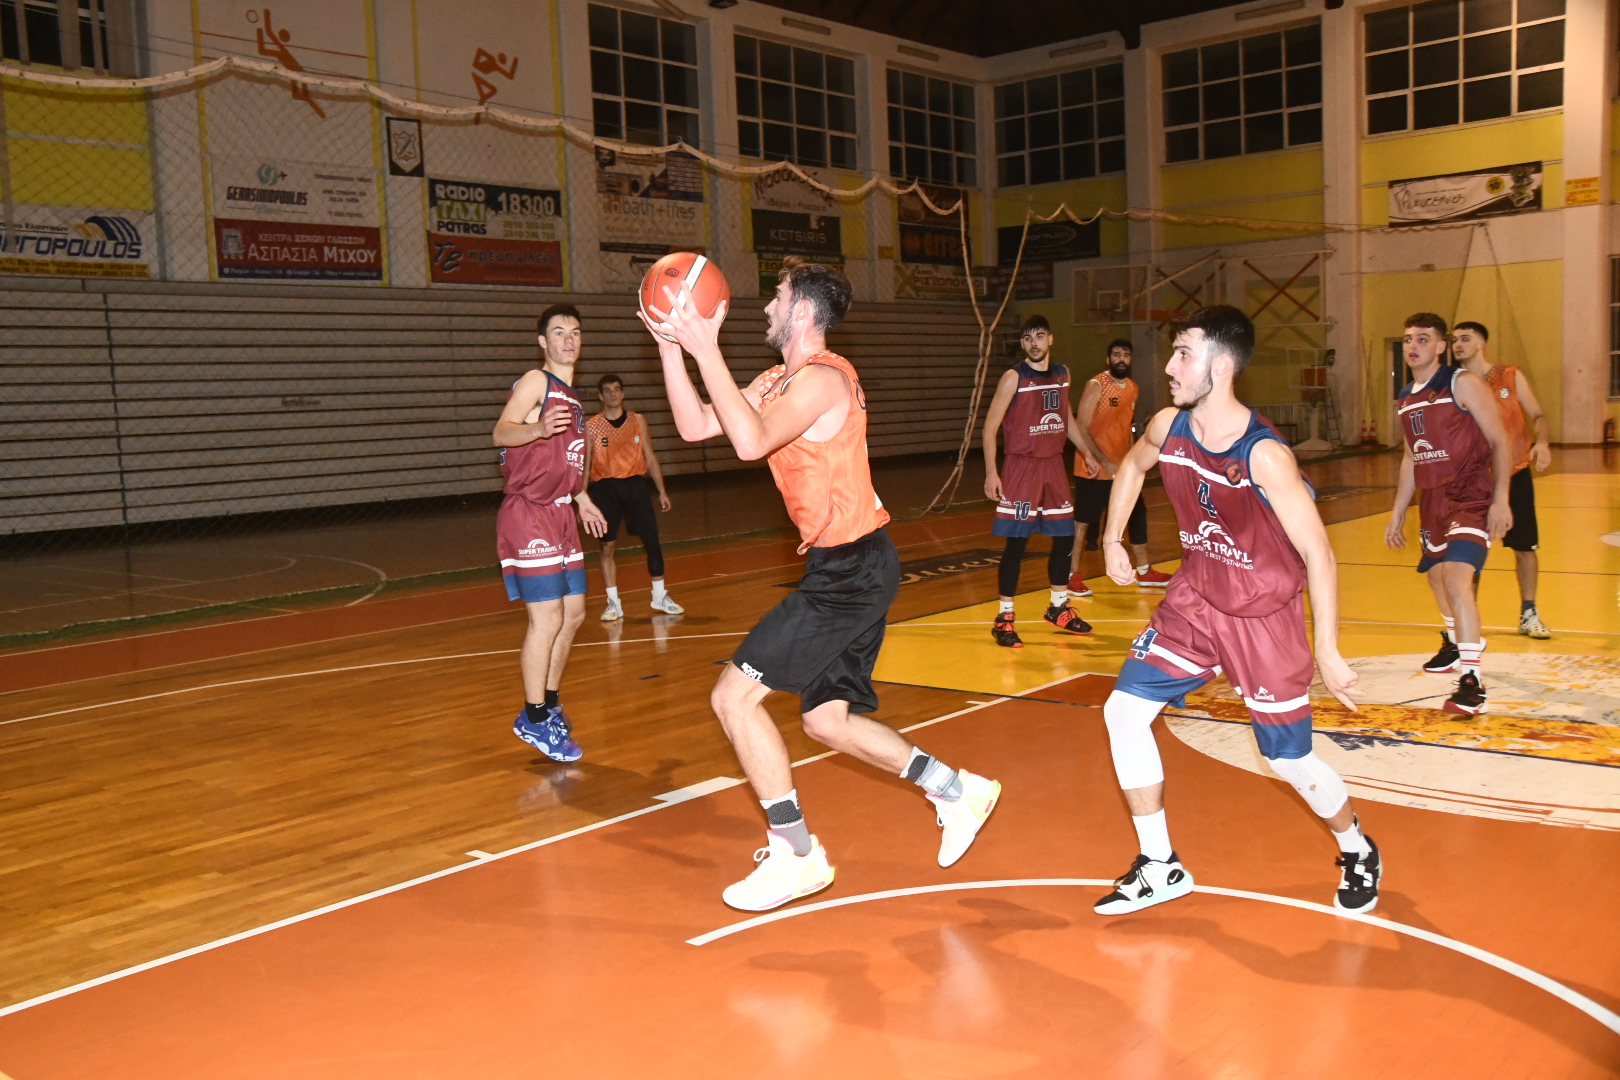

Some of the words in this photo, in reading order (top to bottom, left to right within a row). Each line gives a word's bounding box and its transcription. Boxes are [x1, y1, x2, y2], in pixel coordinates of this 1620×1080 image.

[437, 200, 486, 222] TAXI
[498, 192, 555, 216] 18300
[769, 229, 827, 244] KOTSIRIS
[248, 243, 318, 262] ΑΣΠΑΣΙΑ
[324, 245, 377, 263] ΜΙΧΟΥ
[1042, 390, 1060, 410] 10
[1029, 424, 1049, 433] SUPER
[1409, 409, 1424, 435] 11
[601, 437, 609, 448] 9
[1197, 479, 1217, 518] 4
[1014, 501, 1031, 520] 10
[518, 548, 536, 556] SUPER
[1179, 530, 1212, 551] SUPR
[1212, 541, 1253, 563] TRAVL
[1131, 627, 1158, 660] 4
